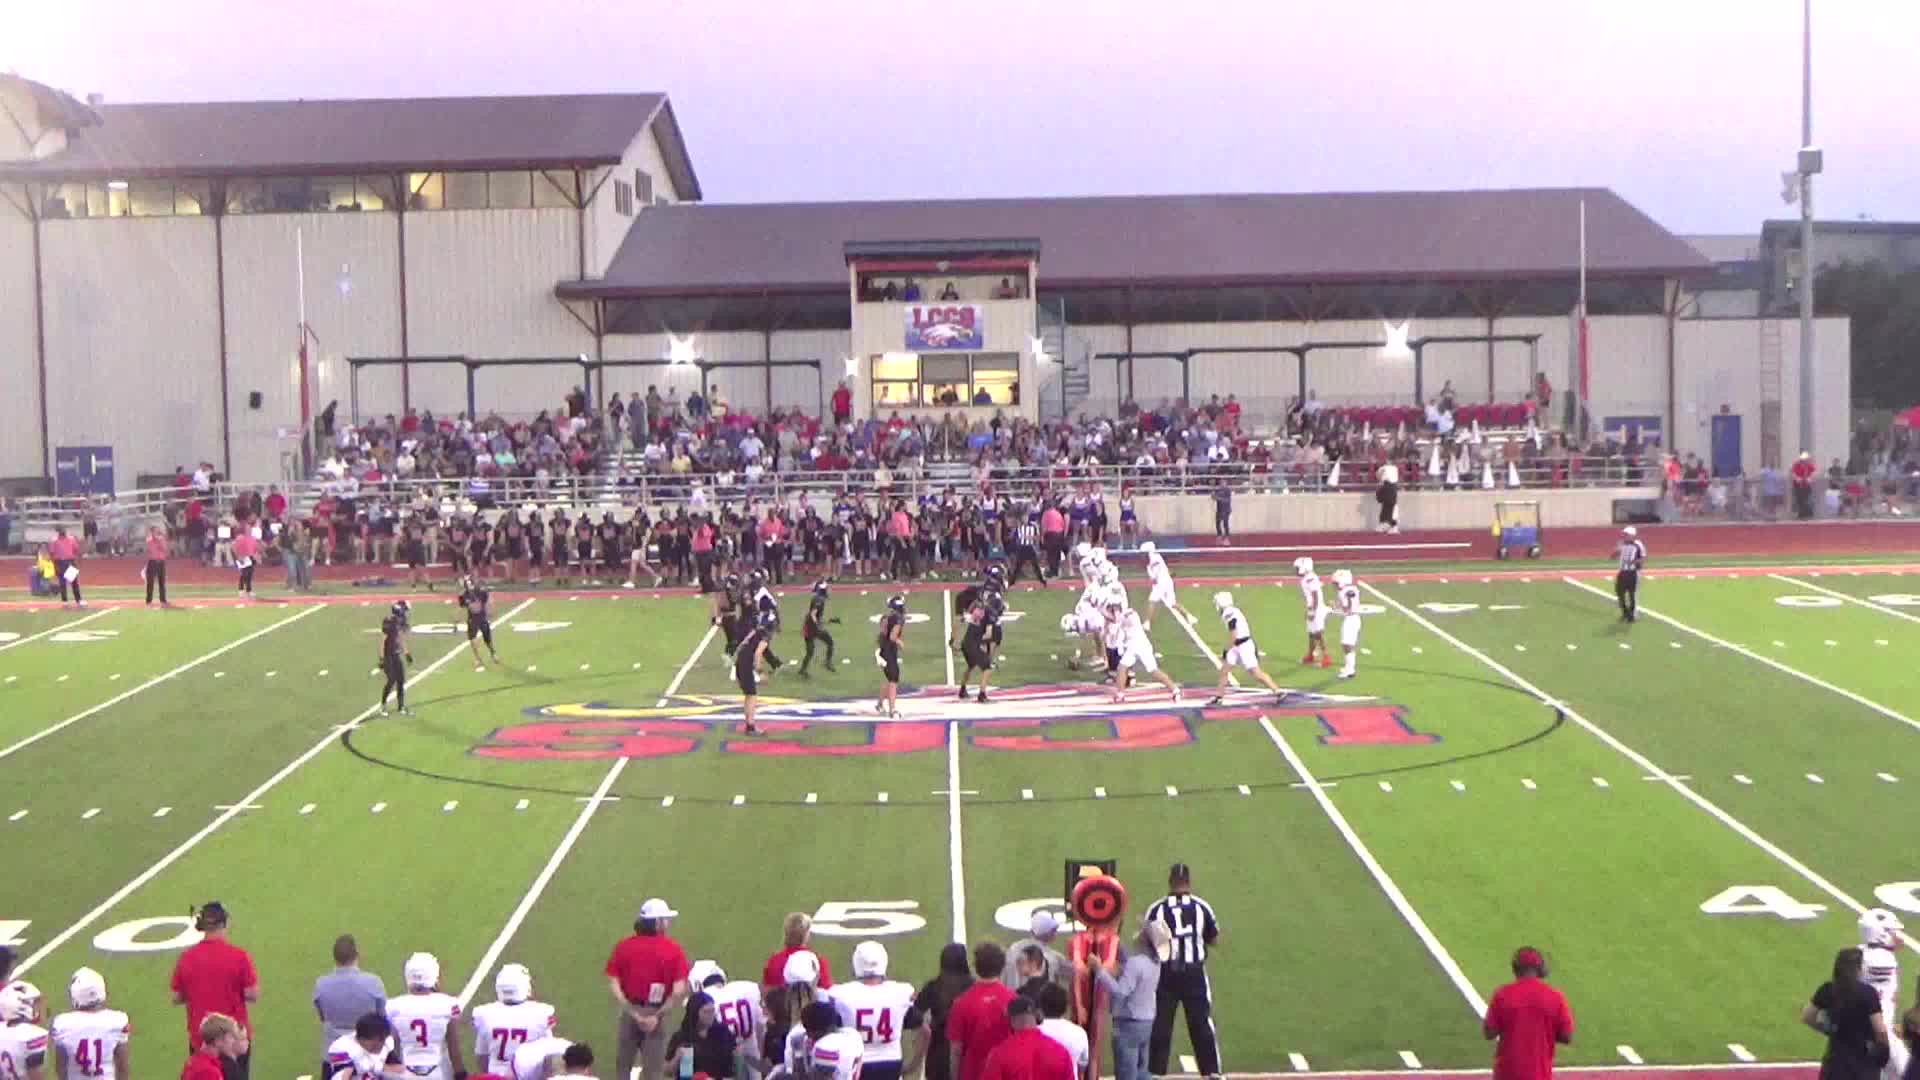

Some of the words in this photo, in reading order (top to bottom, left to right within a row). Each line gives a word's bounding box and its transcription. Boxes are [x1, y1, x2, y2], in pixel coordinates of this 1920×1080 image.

[1171, 907, 1193, 936] L
[410, 1018, 428, 1047] 3
[719, 998, 753, 1039] 50
[856, 1007, 893, 1043] 54
[75, 1037, 104, 1076] 41
